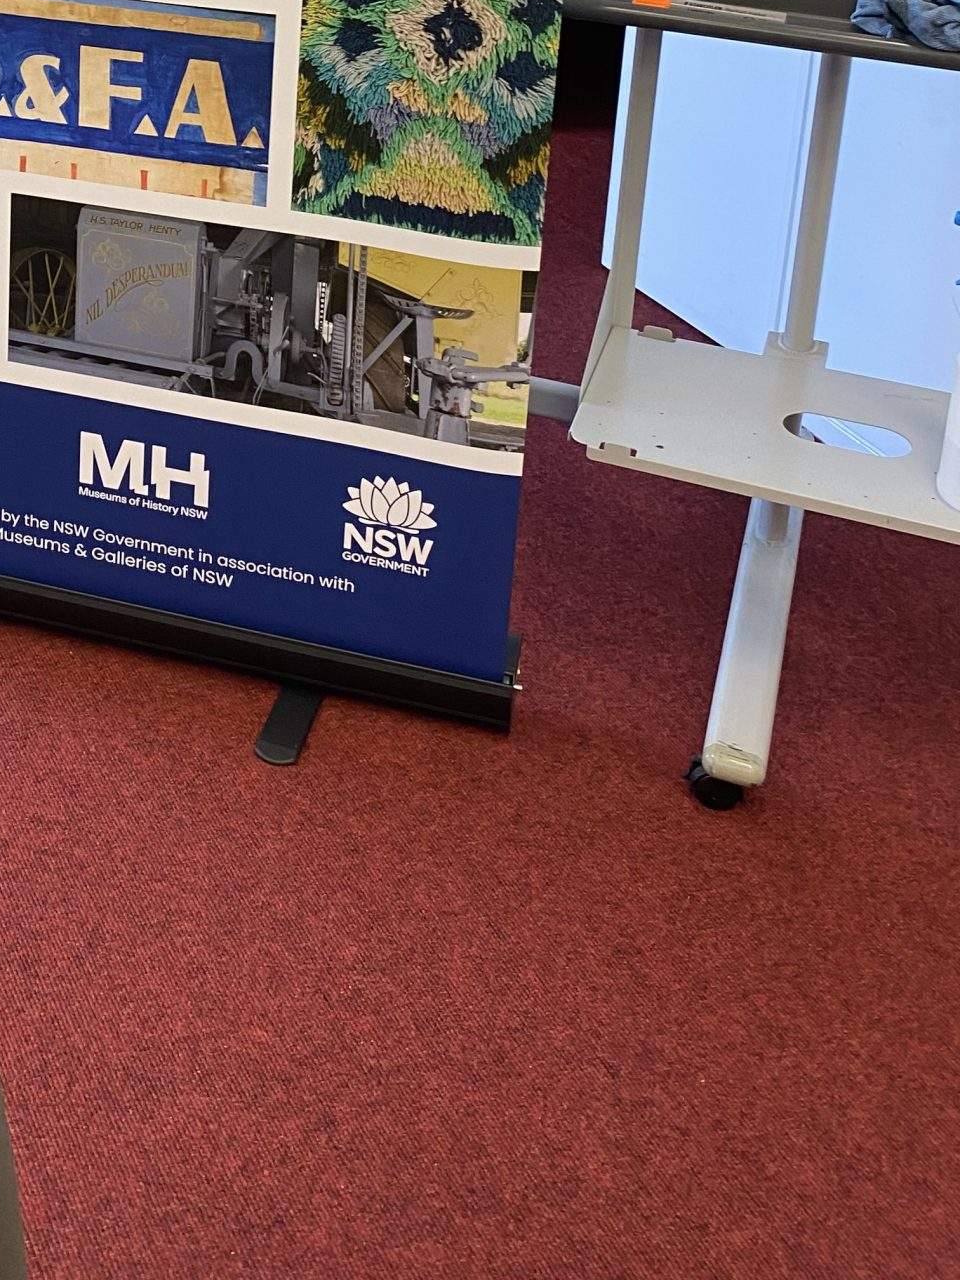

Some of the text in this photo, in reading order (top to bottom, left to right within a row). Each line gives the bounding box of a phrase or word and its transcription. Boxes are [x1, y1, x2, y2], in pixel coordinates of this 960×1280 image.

[110, 218, 143, 231] TAYLOR
[149, 224, 182, 236] HENTY
[78, 486, 208, 520] Museums of History NSW
[1, 509, 20, 527] by
[24, 514, 49, 530] the
[53, 520, 89, 538] NSW
[93, 528, 194, 560] Government
[198, 549, 213, 564] in
[217, 554, 314, 584] association
[319, 574, 355, 592] with
[343, 522, 434, 565] NSW
[74, 544, 88, 558] &
[92, 547, 166, 573] Galleries
[171, 564, 188, 579] of
[193, 567, 234, 588] NSW
[341, 551, 430, 577] GOVERNMENT
